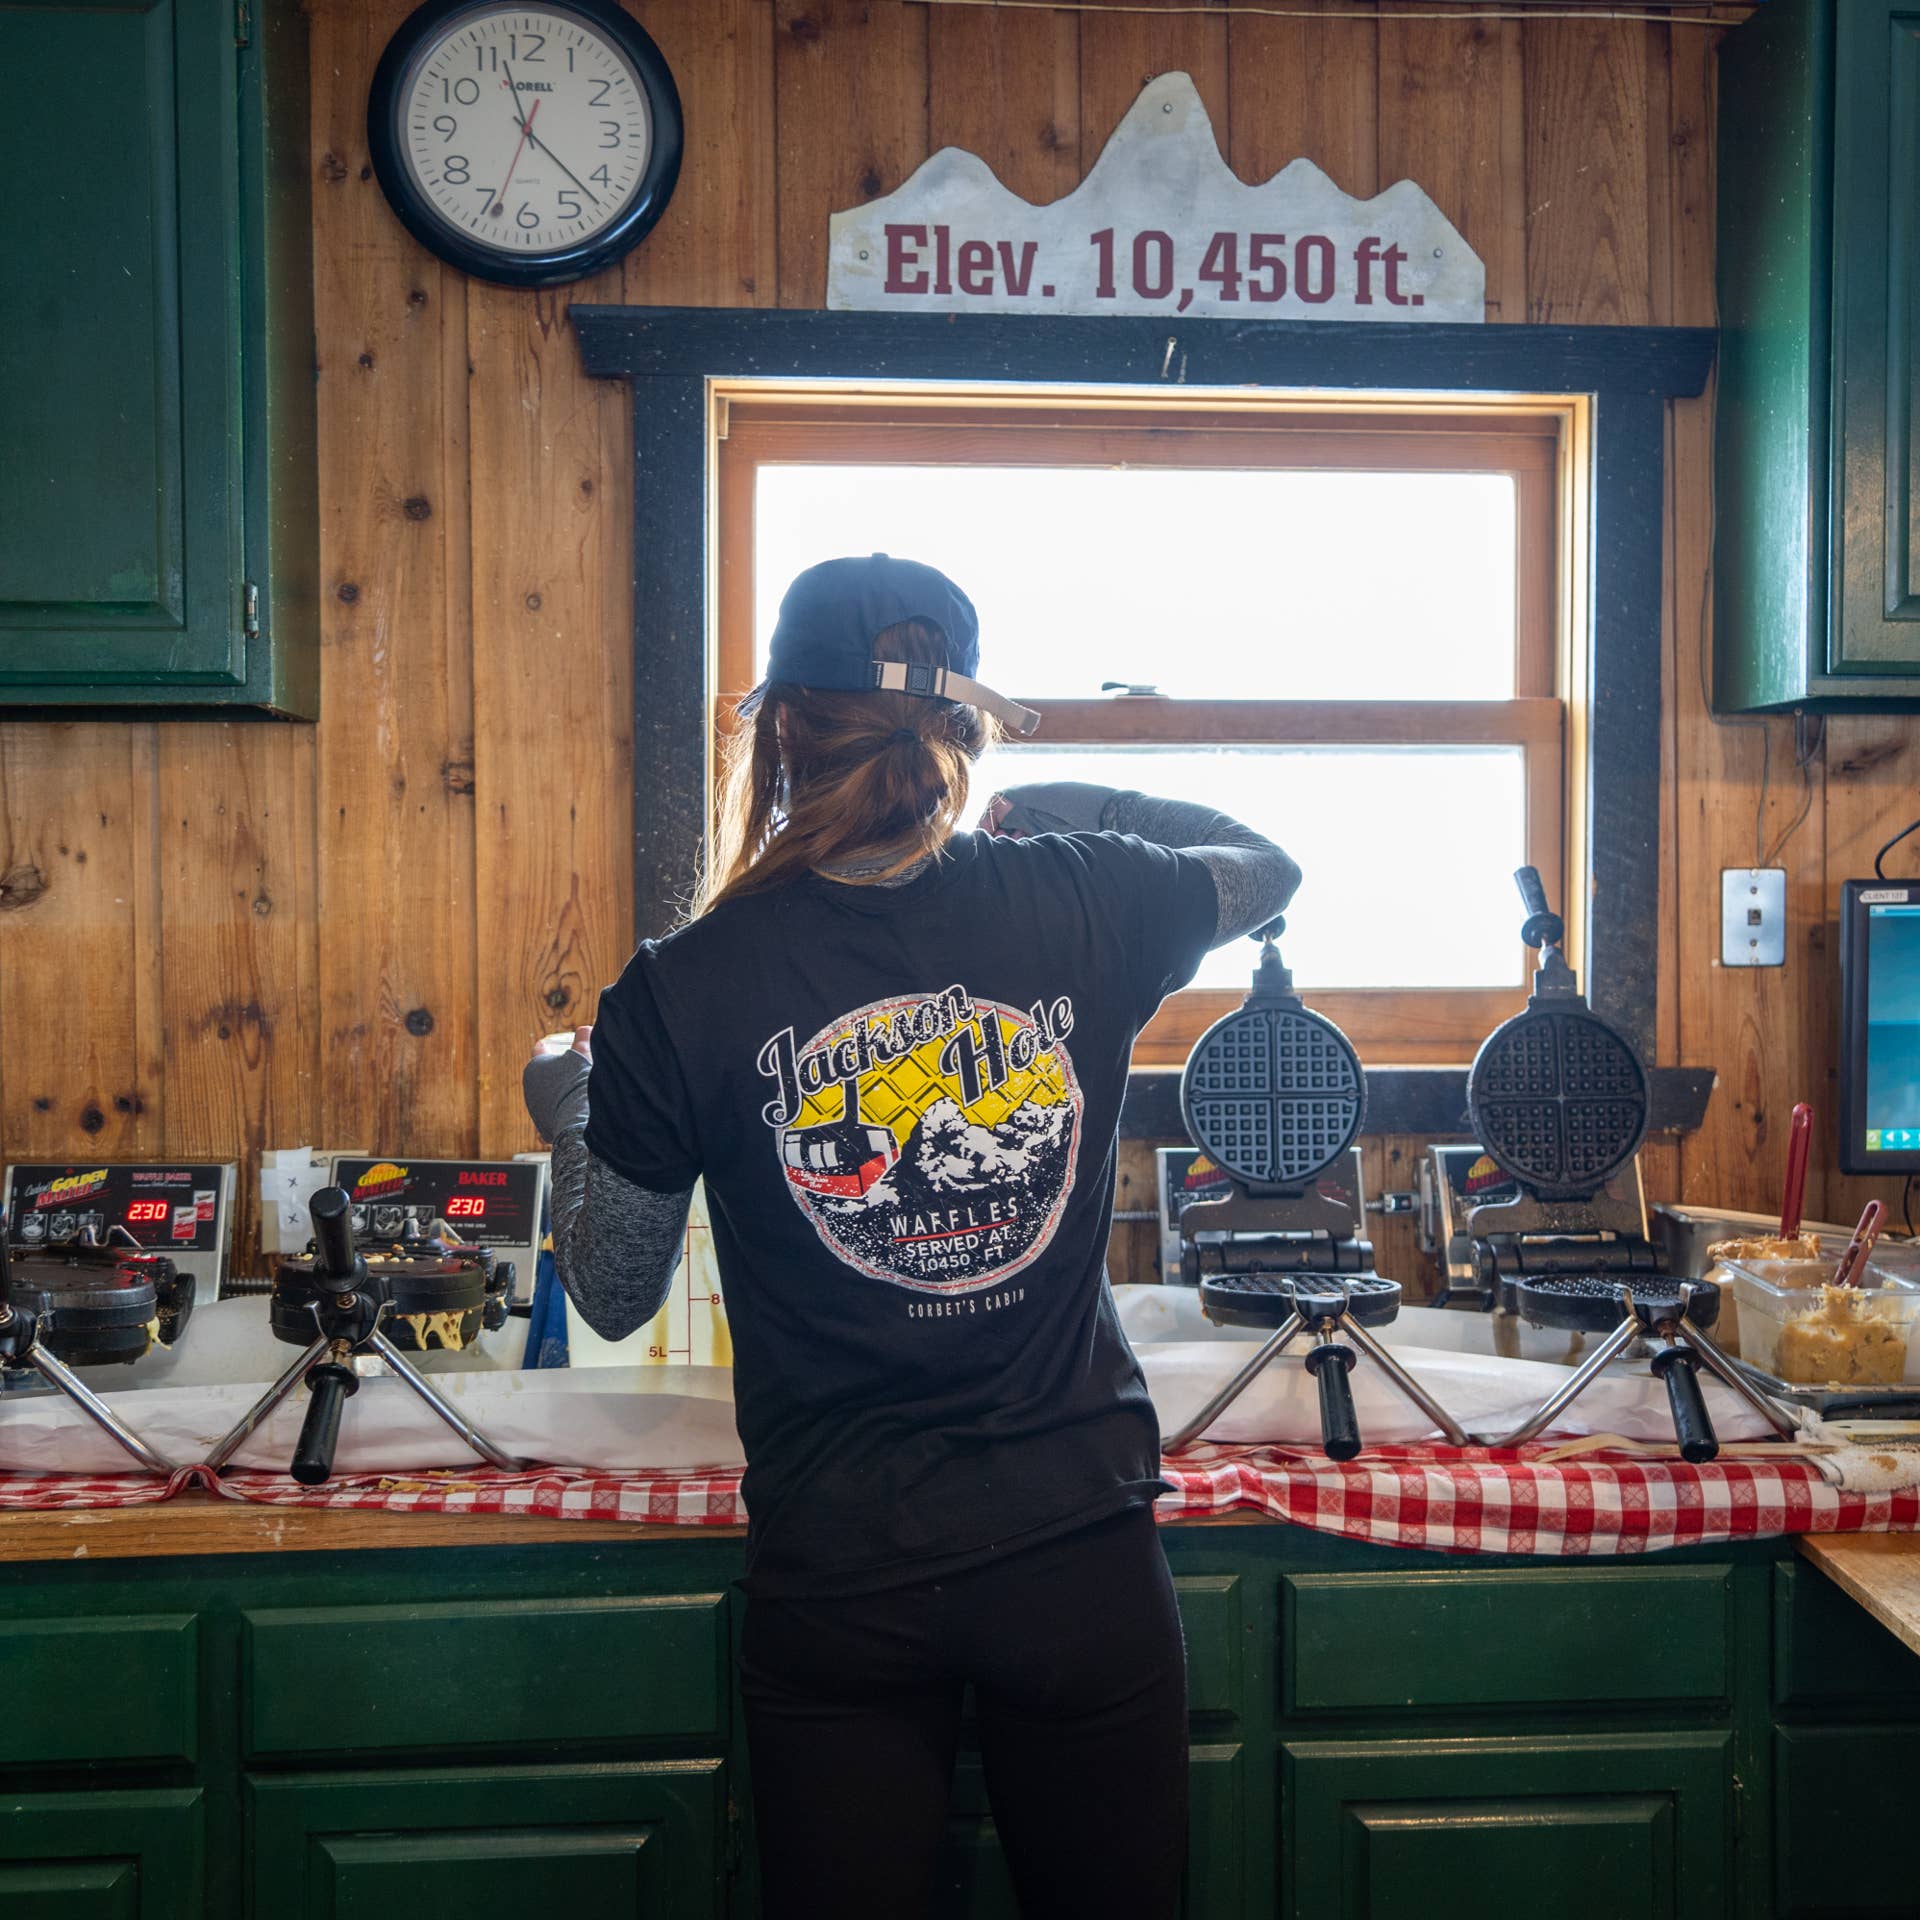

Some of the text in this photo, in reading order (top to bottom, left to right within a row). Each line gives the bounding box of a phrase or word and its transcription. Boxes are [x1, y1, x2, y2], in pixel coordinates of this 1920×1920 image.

[476, 45, 497, 72] 11
[508, 33, 546, 62] 12
[566, 47, 574, 73] 1
[442, 77, 480, 106] 10
[587, 79, 611, 107] 2
[433, 115, 457, 143] 9
[598, 120, 620, 149] 3
[443, 154, 471, 185] 8
[588, 163, 612, 189] 4
[475, 187, 498, 216] 7
[515, 201, 540, 229] 6
[557, 189, 582, 220] 5
[884, 223, 1425, 312] Elev. 10,450 ft.
[757, 983, 1075, 1128] Jackson Hole
[457, 1171, 508, 1186] BAKER
[890, 1197, 1018, 1237] WAFFLES
[906, 1225, 1012, 1258] SERVED AT
[918, 1245, 1004, 1273] 10450 FT
[711, 1293, 721, 1305] 8
[908, 1288, 1025, 1318] CORBET'S CABIN
[649, 1346, 667, 1358] 5L
